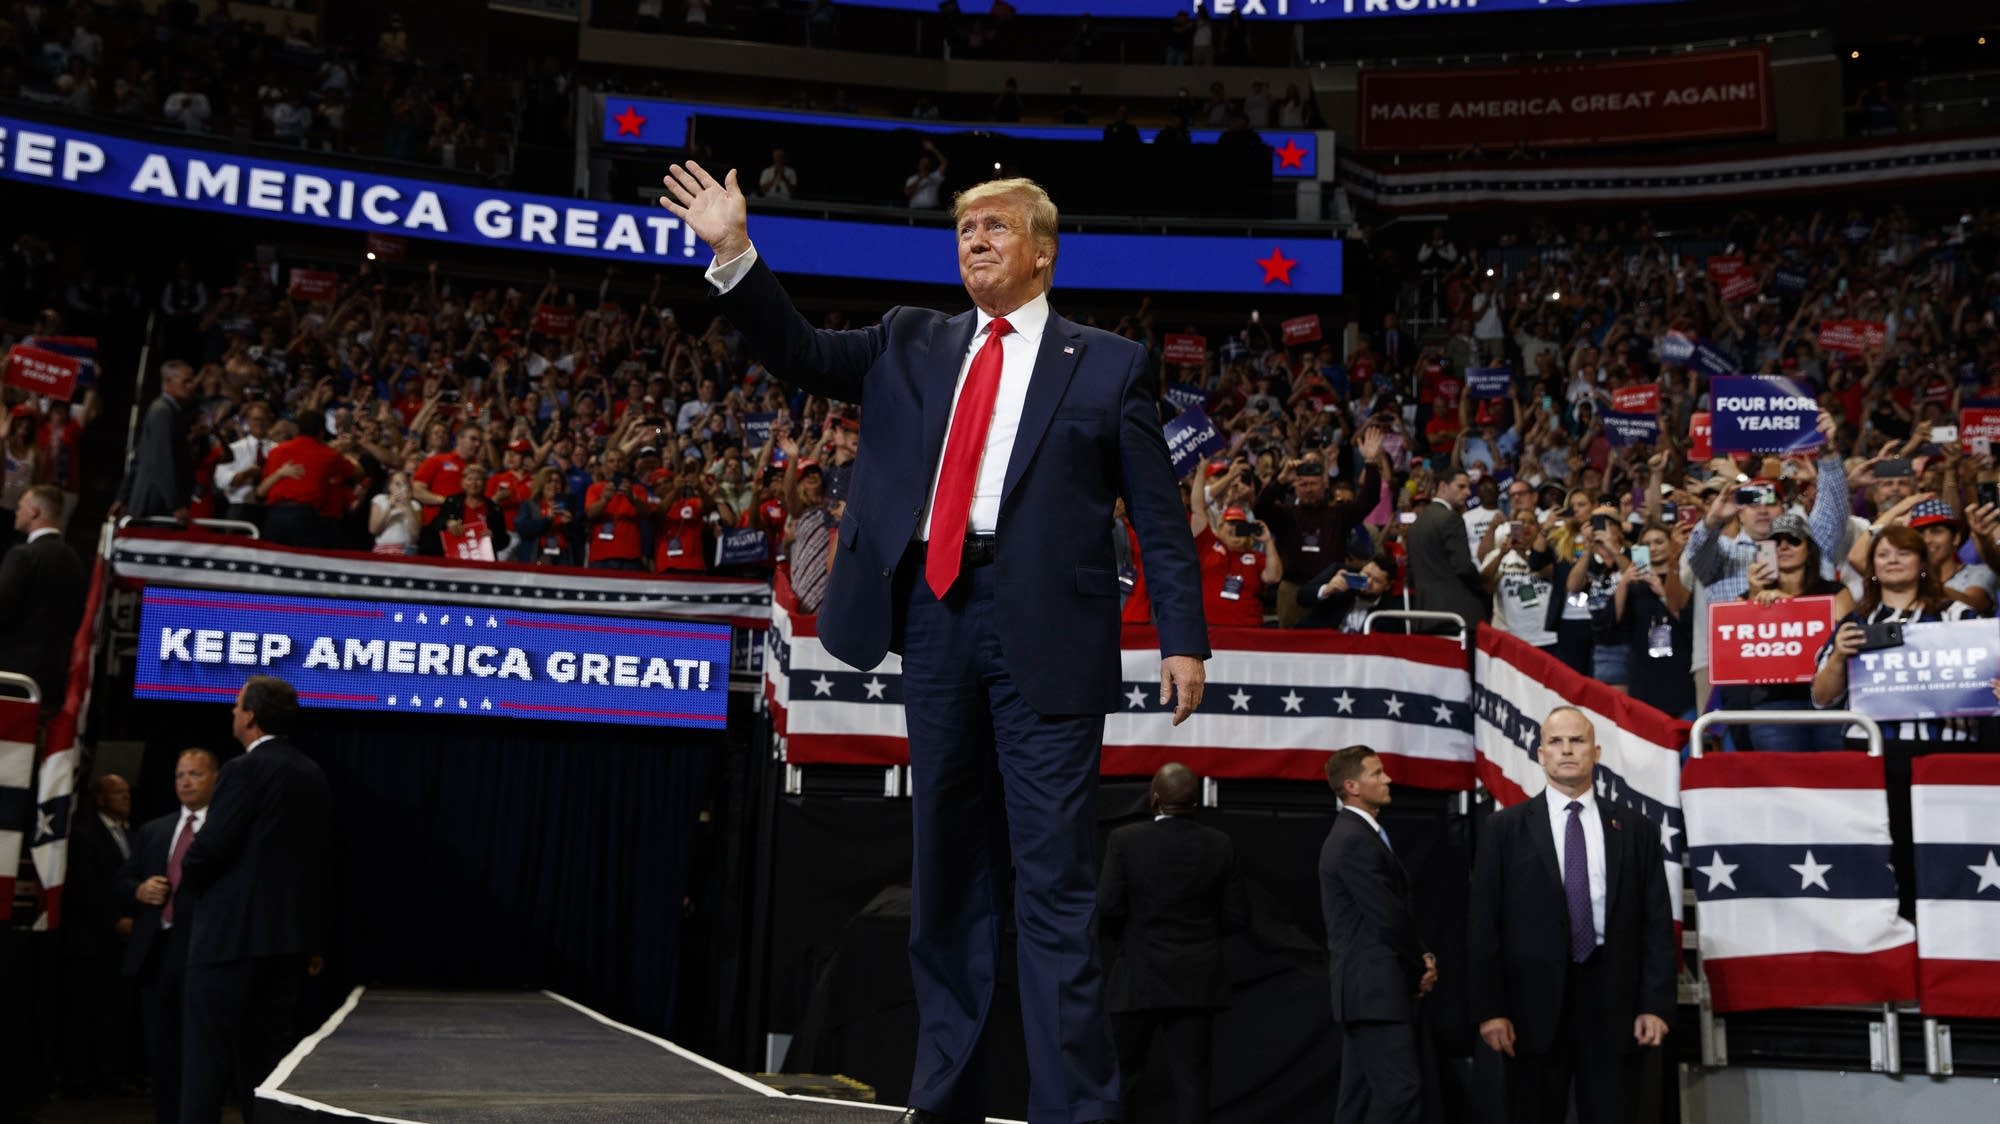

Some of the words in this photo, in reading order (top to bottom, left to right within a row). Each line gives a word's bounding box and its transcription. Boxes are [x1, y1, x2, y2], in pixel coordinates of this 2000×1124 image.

[1370, 102, 1440, 121] MAKE
[1448, 97, 1564, 119] AMERICA
[1570, 90, 1656, 113] GREAT
[1663, 82, 1757, 107] AGAIN!
[0, 126, 106, 182] EP
[130, 153, 448, 233] AMERICA
[473, 198, 696, 258] GREAT!
[1716, 396, 1766, 412] FOUR
[1769, 395, 1818, 412] MORE
[1736, 415, 1801, 431] YEARS!
[1185, 426, 1216, 452] FOUR
[1717, 620, 1825, 640] TRUMP
[159, 627, 292, 666] KEEP
[302, 636, 533, 681] AMERICA
[545, 650, 711, 692] GREAT!
[1740, 640, 1803, 658] 2020
[1859, 647, 1988, 671] TRUMP
[1871, 666, 1978, 684] PENCE
